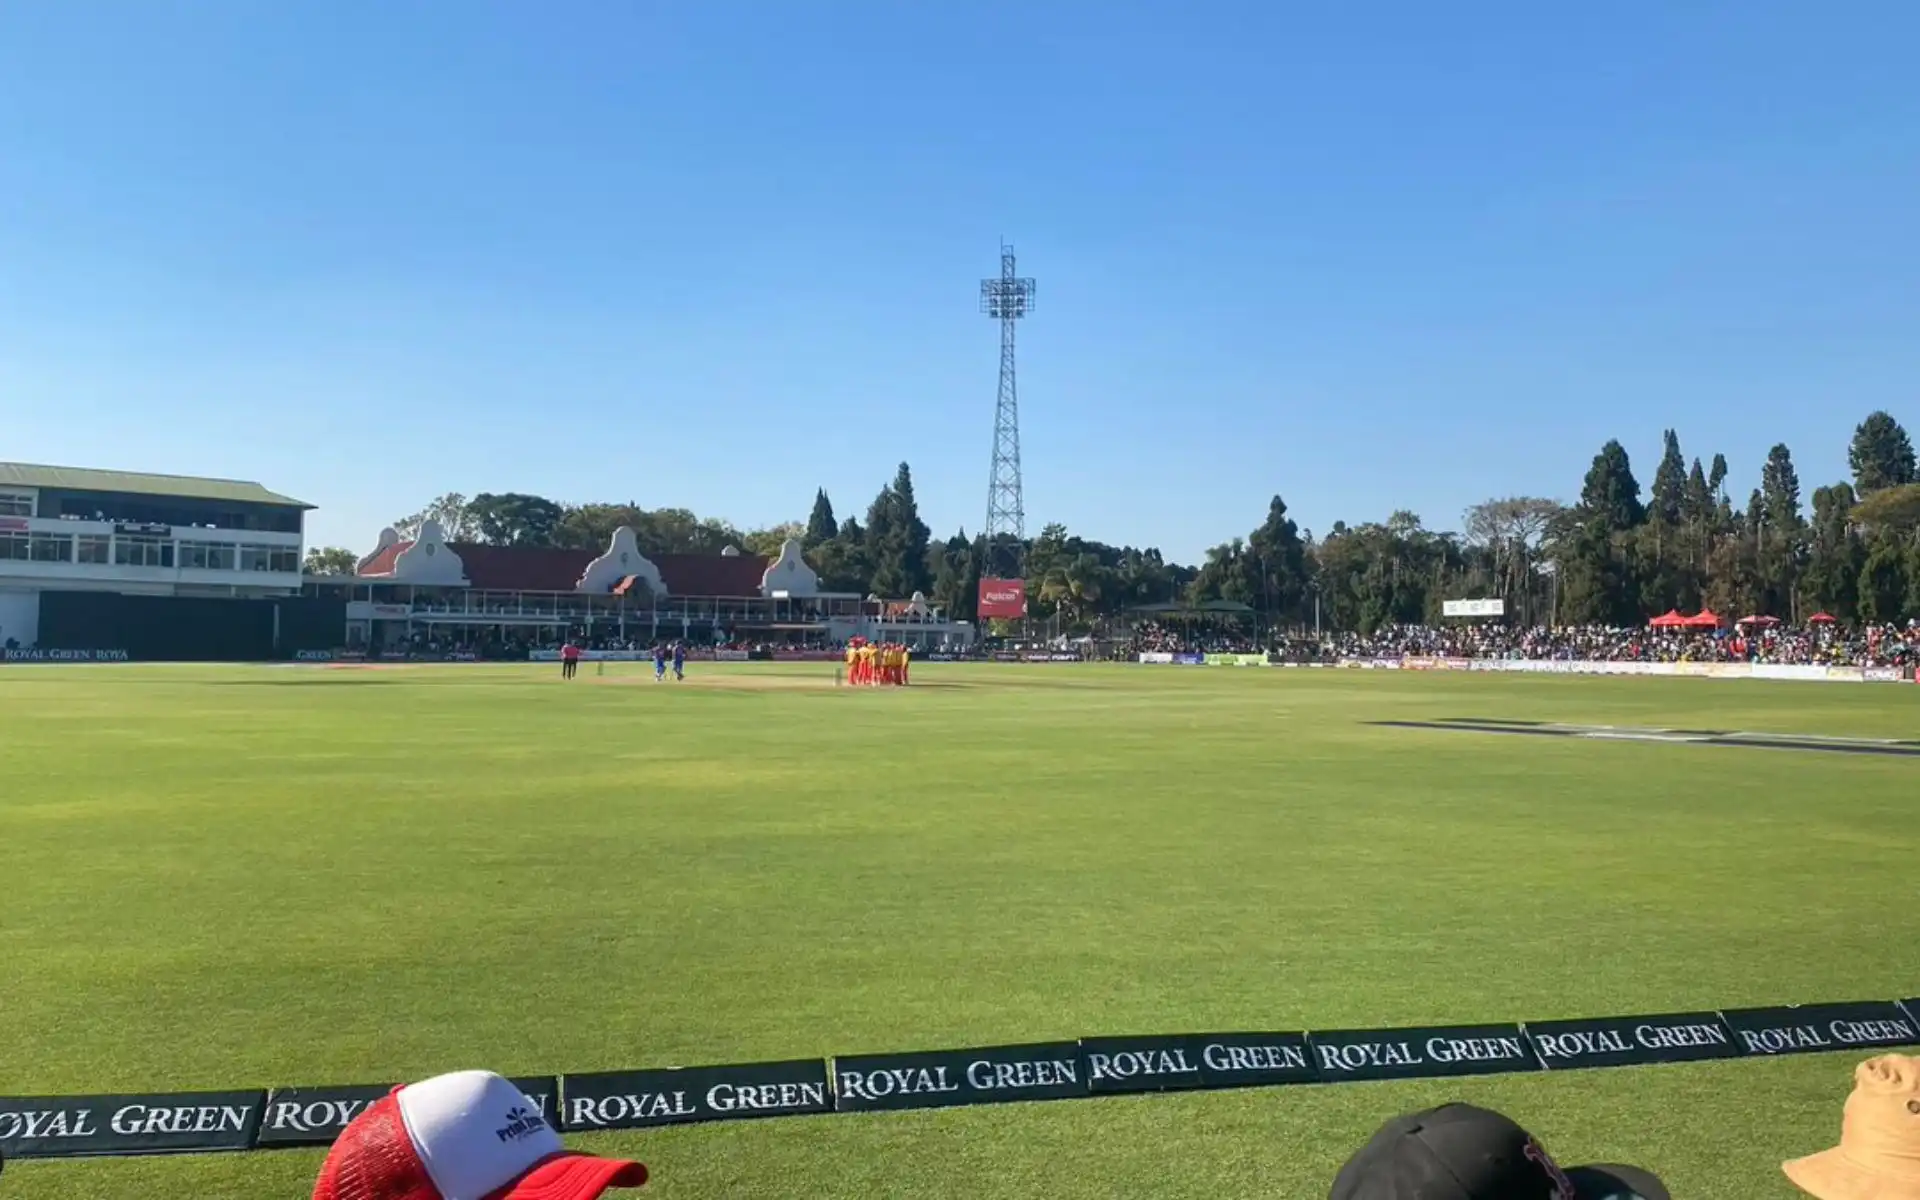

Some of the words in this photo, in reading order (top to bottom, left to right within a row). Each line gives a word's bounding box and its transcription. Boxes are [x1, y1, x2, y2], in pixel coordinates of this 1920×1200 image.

[5, 649, 43, 660] ROYAL
[96, 649, 129, 660] ROYA
[1535, 1030, 1634, 1058] ROYAL
[1635, 1024, 1727, 1049] GREEN
[1741, 1025, 1831, 1053] ROYAL
[1829, 1020, 1916, 1043] GREEN
[1089, 1049, 1198, 1080] ROYAL
[1203, 1043, 1307, 1071] GREEN
[1317, 1042, 1422, 1071] ROYAL
[1426, 1037, 1524, 1063] GREEN
[840, 1066, 958, 1100] ROYAL
[967, 1060, 1076, 1090] GREEN
[271, 1100, 376, 1132] ROY
[570, 1091, 696, 1124] ROYAL
[706, 1083, 824, 1111] GREEN
[0, 1109, 97, 1139] OYAL
[111, 1105, 252, 1134] GREEN
